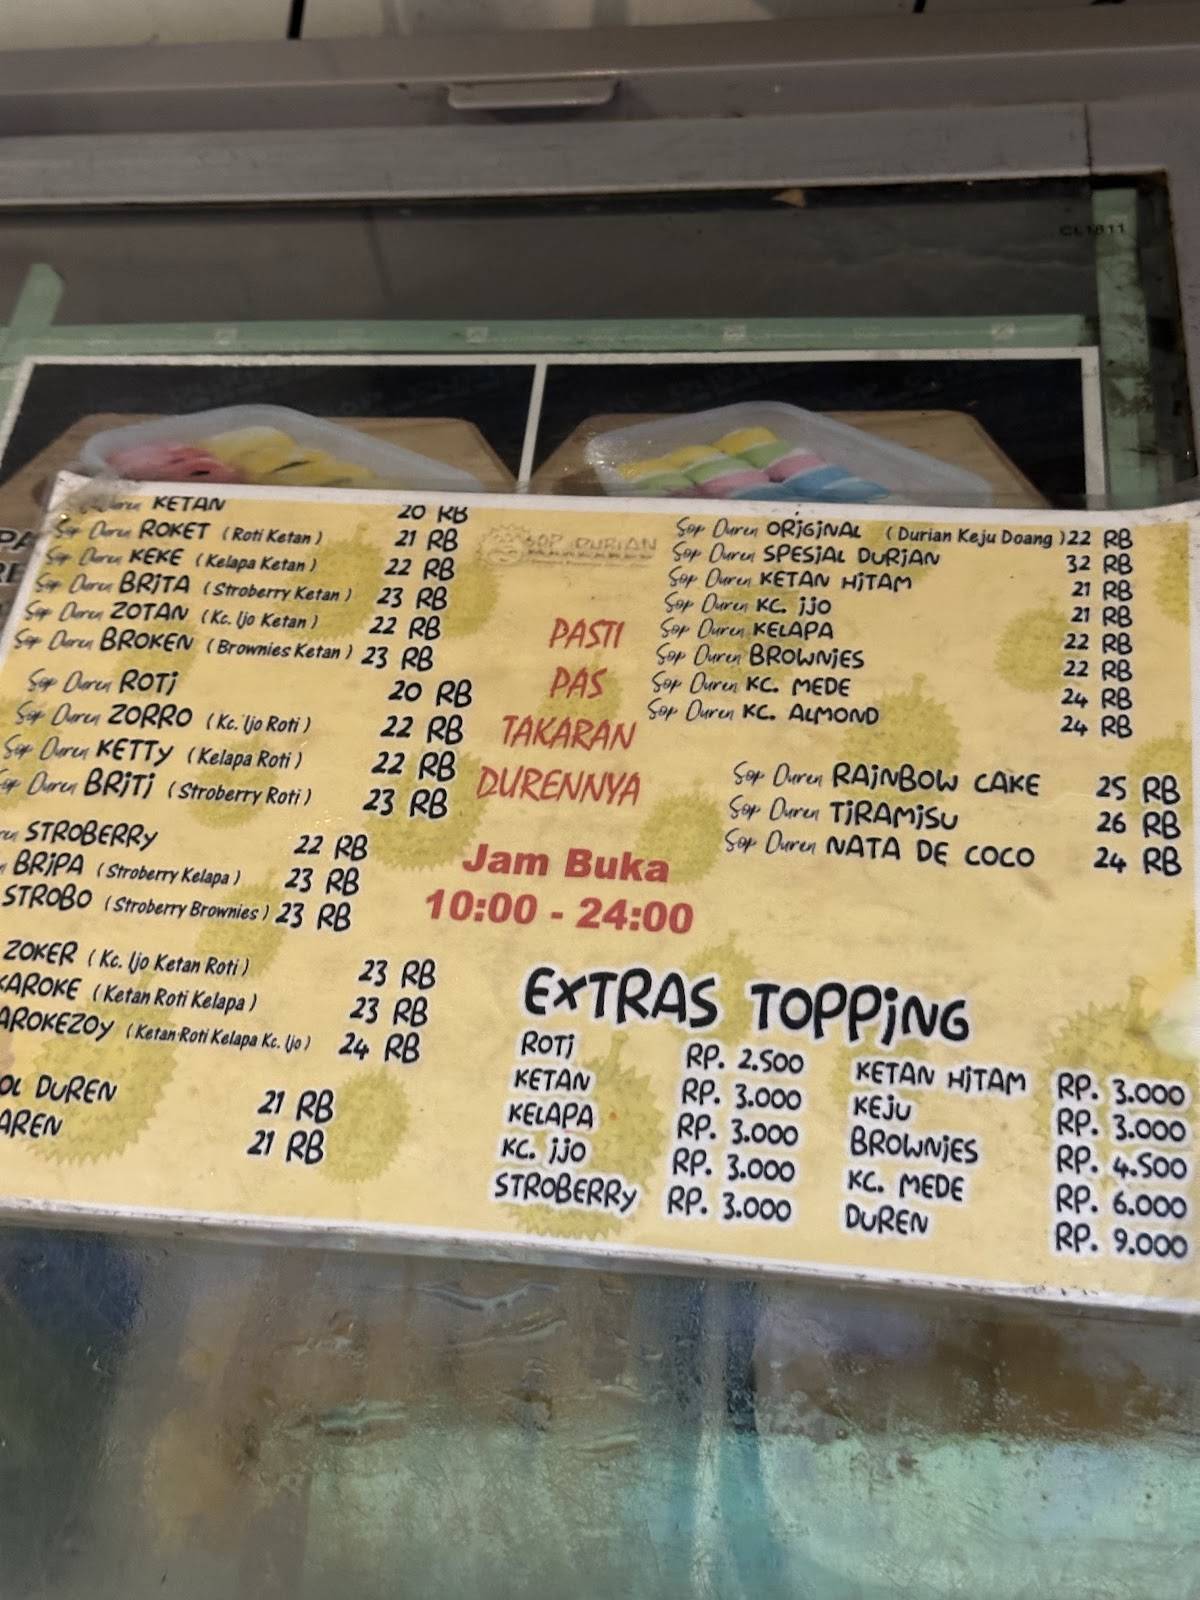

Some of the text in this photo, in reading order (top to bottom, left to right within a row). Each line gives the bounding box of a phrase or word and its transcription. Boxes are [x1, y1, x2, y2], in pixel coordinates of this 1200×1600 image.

[153, 496, 225, 511] KETAN
[398, 505, 426, 520] 20
[139, 519, 211, 539] ROKET
[395, 528, 458, 552] 21 RB
[712, 518, 758, 538] Duren
[767, 519, 861, 539] ORIGINAL
[958, 529, 996, 547] Keju
[1067, 528, 1133, 549] 22 RB
[129, 548, 184, 566] KEKE
[384, 557, 454, 581] 22 RB
[764, 544, 940, 567] SPESIAL DURIAN
[119, 571, 189, 594] BRITA
[760, 571, 911, 592] KETAN HITAM
[110, 602, 189, 620] ZOTAN
[377, 586, 447, 610] 23 RB
[701, 593, 748, 613] Duren
[757, 598, 786, 613] KC.
[100, 626, 193, 652] BROKEN
[549, 618, 625, 648] PASTI
[753, 621, 833, 640] KELAPA
[1065, 633, 1132, 655] 22 RB
[361, 646, 433, 671] 23 RB
[694, 644, 741, 666] Duren
[750, 643, 864, 669] BROWNIES
[119, 669, 178, 695] ROTI
[550, 666, 607, 699] PAS
[1064, 659, 1132, 682] 22 RB
[388, 679, 472, 708] 20 RB
[746, 677, 851, 696] KC. MEDE
[1062, 687, 1132, 710] 24 RB
[108, 704, 192, 729] ZORRO
[743, 704, 879, 725] KC. ALMOND
[1061, 715, 1132, 738] 24 RB
[503, 715, 636, 751] TAKARAN
[96, 738, 174, 767] KETTY
[372, 751, 455, 781] 22 RB
[477, 766, 640, 806] DURENNYA
[773, 763, 822, 787] Duren
[833, 762, 958, 792] RAINBOW
[974, 771, 1040, 796] CAKE
[1096, 775, 1180, 805] 25 RB
[363, 788, 447, 819] 23 RB
[830, 800, 958, 830] TIRAMISU
[25, 820, 158, 851] STROBERRY
[1097, 811, 1181, 839] 26 RB
[294, 835, 367, 861] 22 RB
[765, 830, 816, 854] Duren
[827, 835, 900, 860] NATA
[917, 840, 948, 867] DE
[965, 846, 1034, 867] COCO
[1094, 846, 1182, 876] 24 RB
[13, 849, 83, 876] BRIPA
[463, 844, 669, 882] Jam Buka
[285, 867, 359, 896] 23 RB
[2, 884, 92, 911] STROBO
[426, 889, 693, 934] 10:00 24:00
[3, 940, 78, 966] ZOKER
[154, 954, 200, 973] Ketan
[359, 959, 435, 990] 23 RB
[154, 988, 189, 1007] Roti
[525, 967, 969, 1045] EXTRAS TOPPING
[0, 1007, 114, 1041] AROKEZOY
[350, 997, 427, 1027] 23 RB
[339, 1032, 419, 1064] 24 RB
[522, 1031, 574, 1059] ROTI
[687, 1043, 804, 1074] RP. 2.500
[36, 1075, 117, 1103] DUREN
[515, 1068, 801, 1110] KETAN RP. 3.000
[857, 1061, 1185, 1106] KETAN HITAM RP. 3.000
[258, 1090, 333, 1123] 21 RB
[854, 1095, 1185, 1142] KEJU RP. 3.000
[0, 1109, 62, 1138] AREN
[509, 1102, 798, 1146] KELAPA RP. 3.000
[247, 1130, 324, 1164] 21 RB
[502, 1138, 535, 1159] KC.
[673, 1148, 712, 1176] RP.
[728, 1154, 795, 1182] 3.000
[851, 1126, 1187, 1179] BROWNIES RP. 4.500
[495, 1172, 791, 1222] STROBERRY RP. 3.000
[849, 1170, 1187, 1219] KC. MEDE RP. 6.000
[846, 1204, 1187, 1258] DUREN RP. 9.000
